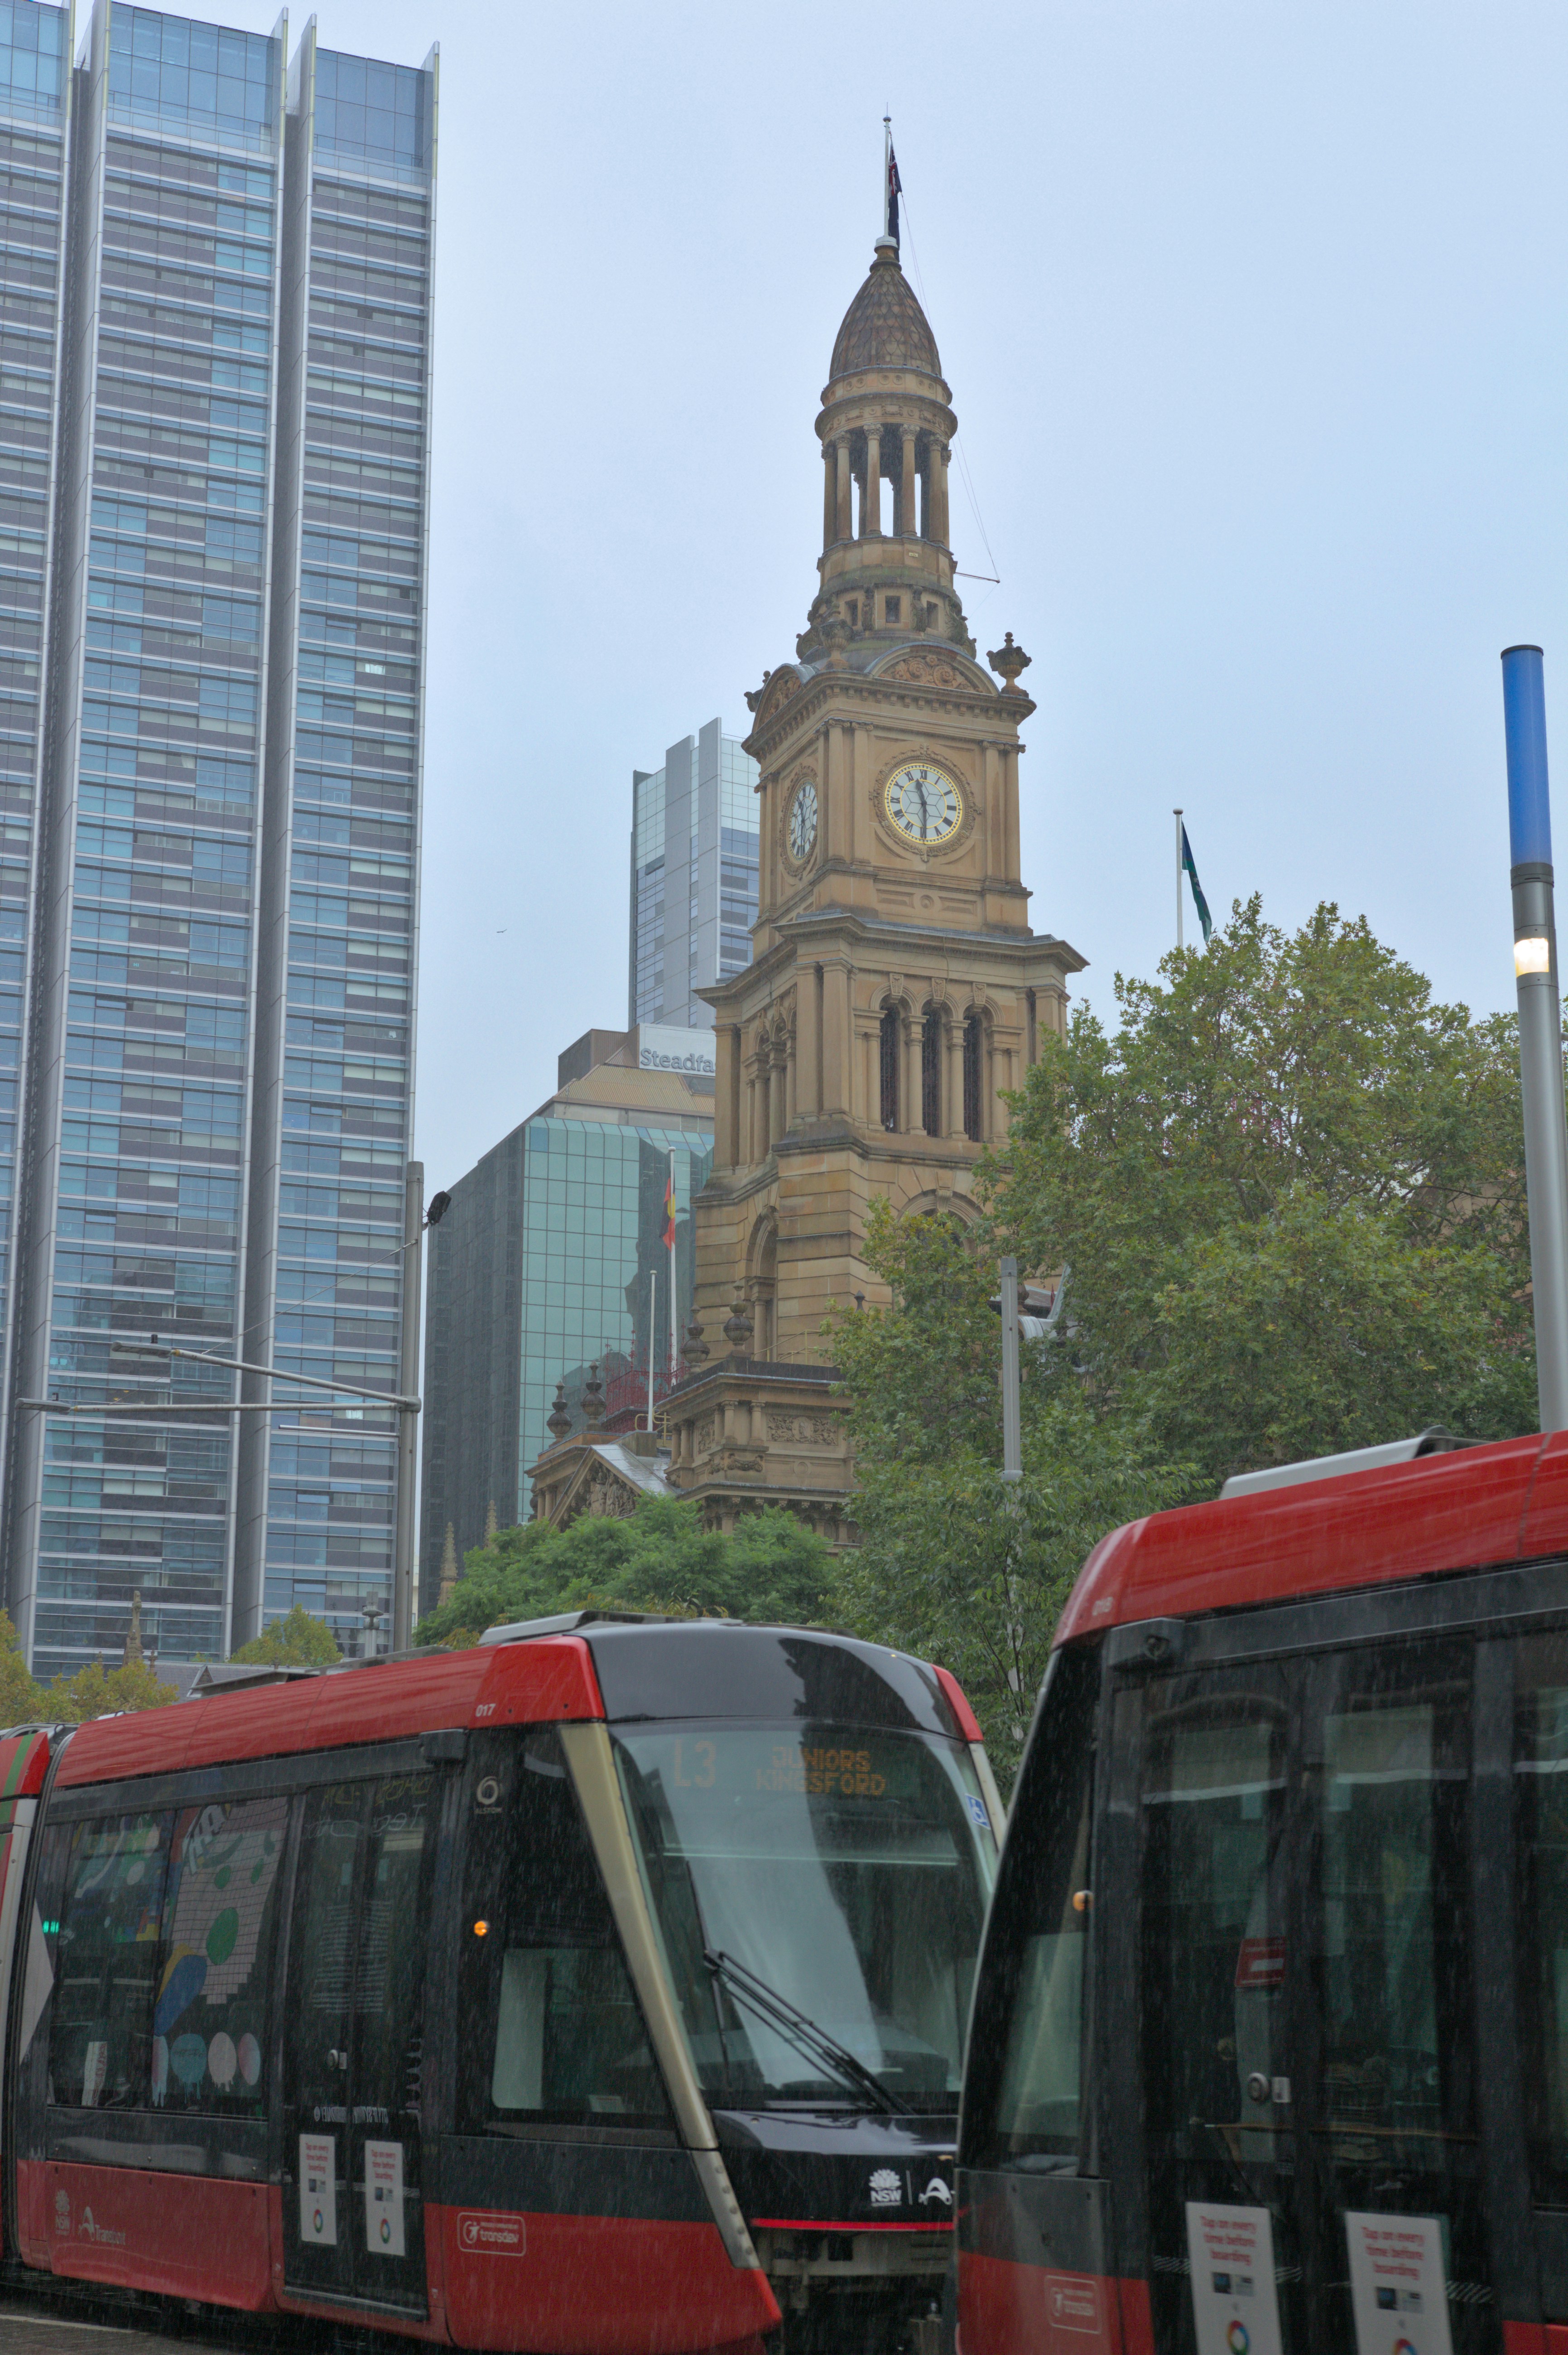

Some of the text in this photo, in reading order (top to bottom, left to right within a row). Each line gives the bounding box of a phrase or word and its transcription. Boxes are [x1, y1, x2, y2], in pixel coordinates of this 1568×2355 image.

[640, 1048, 716, 1073] Steadfa
[476, 1704, 496, 1717] 017
[674, 1738, 717, 1788] L3
[772, 1747, 871, 1772] JUNIORS
[756, 1769, 885, 1795] KINGSFORD
[870, 2189, 902, 2202] NSW
[1200, 2215, 1215, 2230] Tap
[1232, 2221, 1256, 2234] every
[1203, 2232, 1256, 2247] time before
[1361, 2226, 1425, 2247] Tap on every
[1210, 2248, 1251, 2266] boarding
[1366, 2244, 1424, 2260] time before
[1372, 2260, 1419, 2280] boarding
